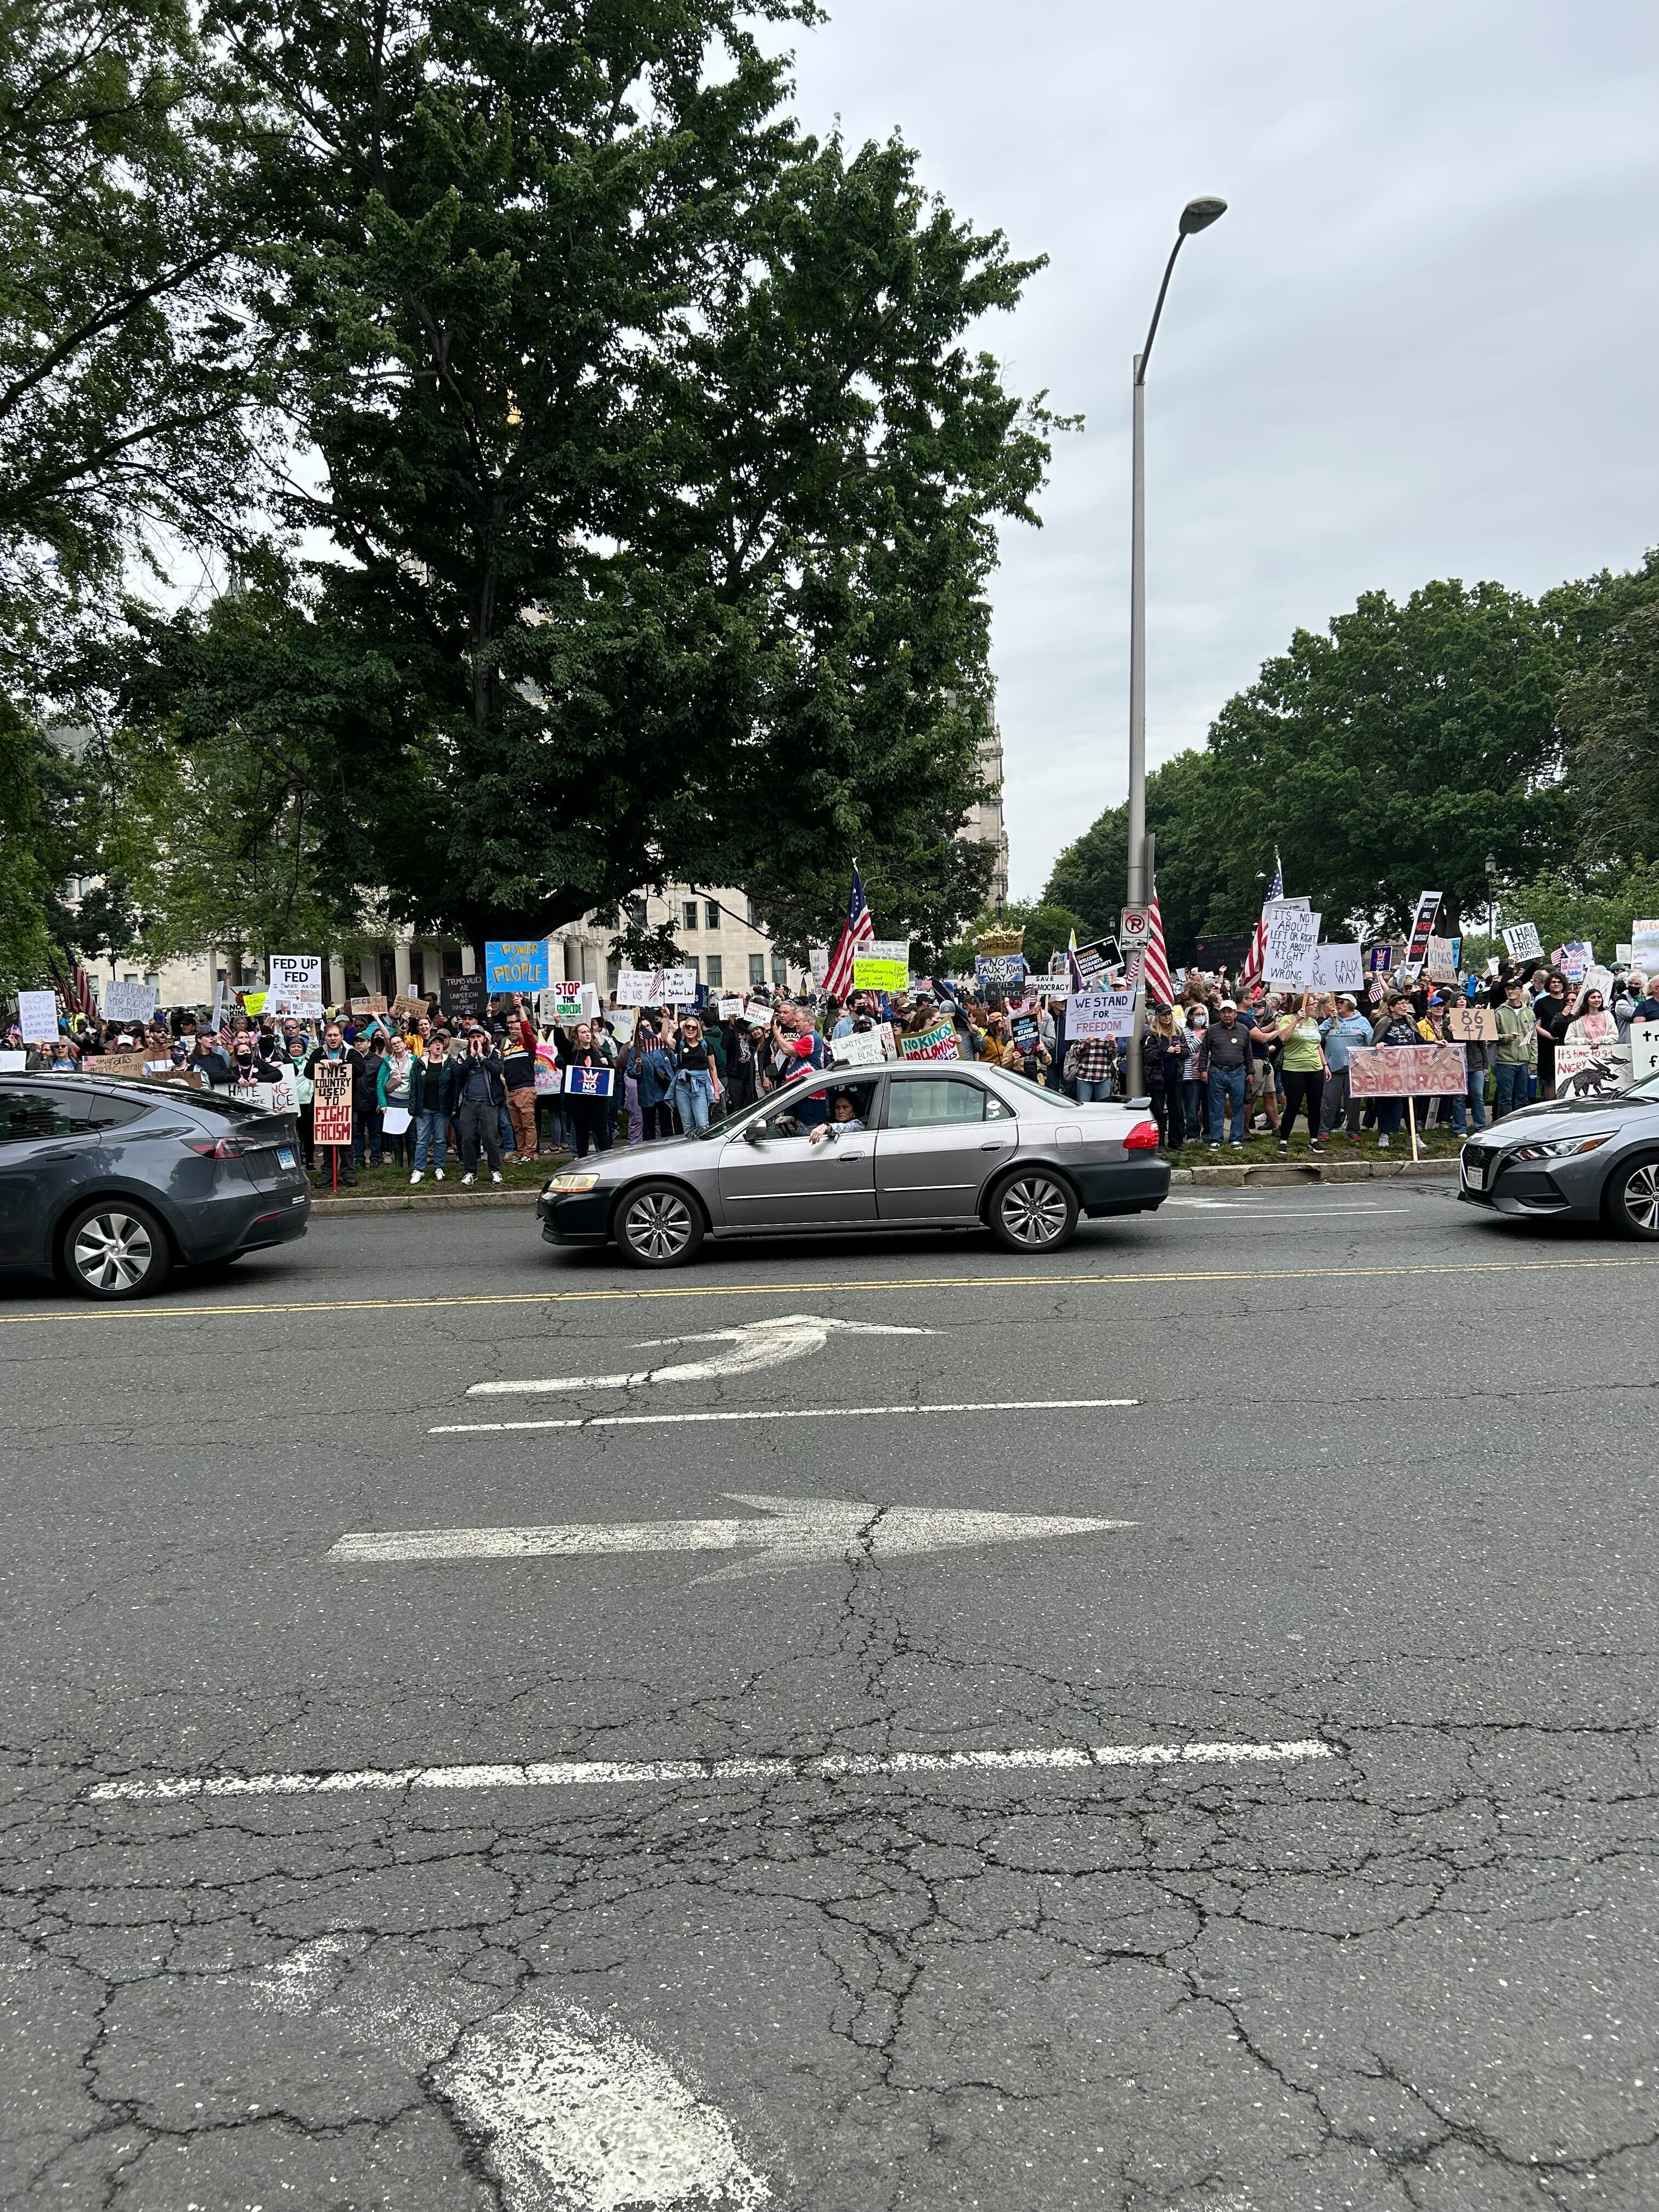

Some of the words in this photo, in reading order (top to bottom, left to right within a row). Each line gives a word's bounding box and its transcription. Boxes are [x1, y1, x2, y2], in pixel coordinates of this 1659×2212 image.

[1273, 910, 1291, 921] IT'S
[1300, 913, 1316, 923] NOT
[1277, 921, 1309, 932] ABOUT
[1271, 930, 1288, 940] LEFT
[1289, 932, 1298, 941] OR
[1509, 930, 1515, 943] I
[1515, 925, 1536, 941] HAVE
[501, 943, 537, 956] POWER
[1002, 941, 1019, 950] 1776
[1289, 943, 1312, 952] ABOUT
[1434, 938, 1444, 950] NO
[1078, 953, 1099, 964] WELCOME
[1274, 950, 1305, 961] RIGHT
[1430, 949, 1452, 964] KINGS
[273, 958, 297, 969] FED
[301, 959, 318, 969] UP
[989, 958, 1005, 966] NO
[1283, 960, 1293, 969] OR
[1335, 960, 1360, 973] FAUX
[493, 963, 542, 983] PEOPLE
[1081, 966, 1094, 974] WITH
[1271, 968, 1302, 981] WRONG
[285, 972, 308, 982] FED
[856, 974, 870, 984] Save
[1335, 972, 1356, 984] WAY
[556, 983, 580, 995] STOP
[25, 995, 49, 1003] GOP
[127, 998, 152, 1010] RACISM
[1075, 998, 1091, 1008] WE
[1094, 996, 1128, 1007] STAND
[106, 1007, 115, 1017] IS
[557, 1004, 582, 1014] GENOCIDE
[678, 1006, 699, 1015] MERIC
[749, 1003, 774, 1013] IMMIGRANTS
[611, 1015, 632, 1025] KINGS
[746, 1012, 766, 1020] AMERICA
[1462, 1011, 1483, 1025] 86
[1018, 1028, 1034, 1036] STAND
[1076, 1021, 1121, 1033] FREEDOM
[1463, 1025, 1483, 1040] 47
[1014, 1032, 1038, 1042] TOGETHER
[841, 1038, 862, 1049] WHITE
[904, 1040, 918, 1051] NO
[906, 1051, 921, 1060] NO
[920, 1035, 956, 1060] CLOWNS
[858, 1048, 879, 1060] BLACK
[1385, 1050, 1430, 1068] SAVE
[1573, 1049, 1589, 1058] time
[319, 1066, 347, 1078] THIS
[1558, 1060, 1587, 1074] ANGRY
[315, 1078, 351, 1088] COUNTRY
[1351, 1073, 1464, 1092] DEMOCRACY
[228, 1085, 260, 1097] HATE
[319, 1087, 346, 1097] USED
[325, 1097, 339, 1105] TO
[315, 1105, 351, 1122] FIGHT
[315, 1123, 351, 1141] FACISM
